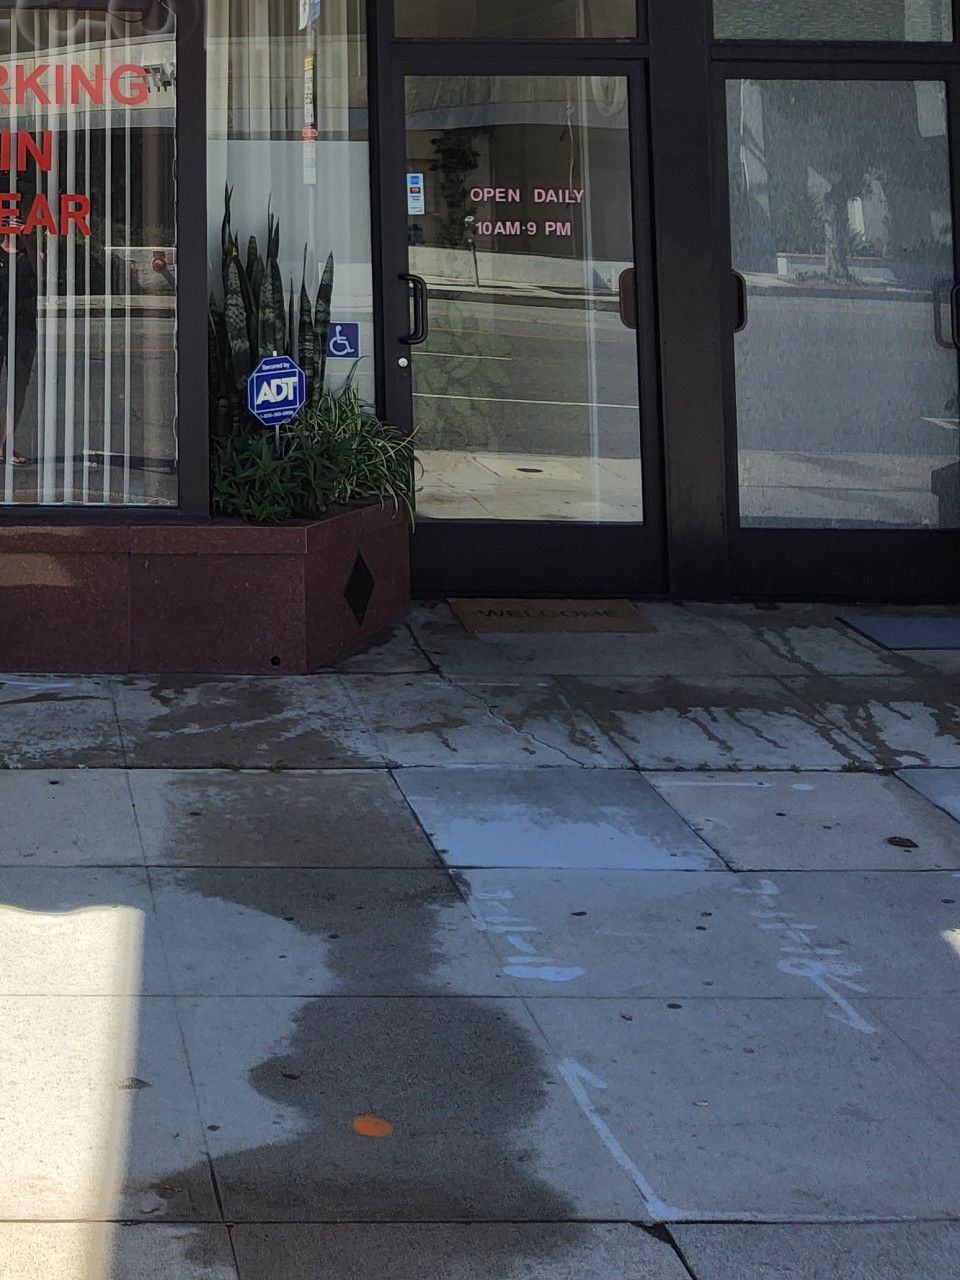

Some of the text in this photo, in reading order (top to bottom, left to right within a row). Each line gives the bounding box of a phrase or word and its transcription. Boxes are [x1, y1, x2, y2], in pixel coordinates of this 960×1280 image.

[0, 129, 52, 172] IN
[470, 188, 584, 203] OPEN DAILY
[545, 221, 571, 236] PM
[256, 376, 298, 405] ADT
